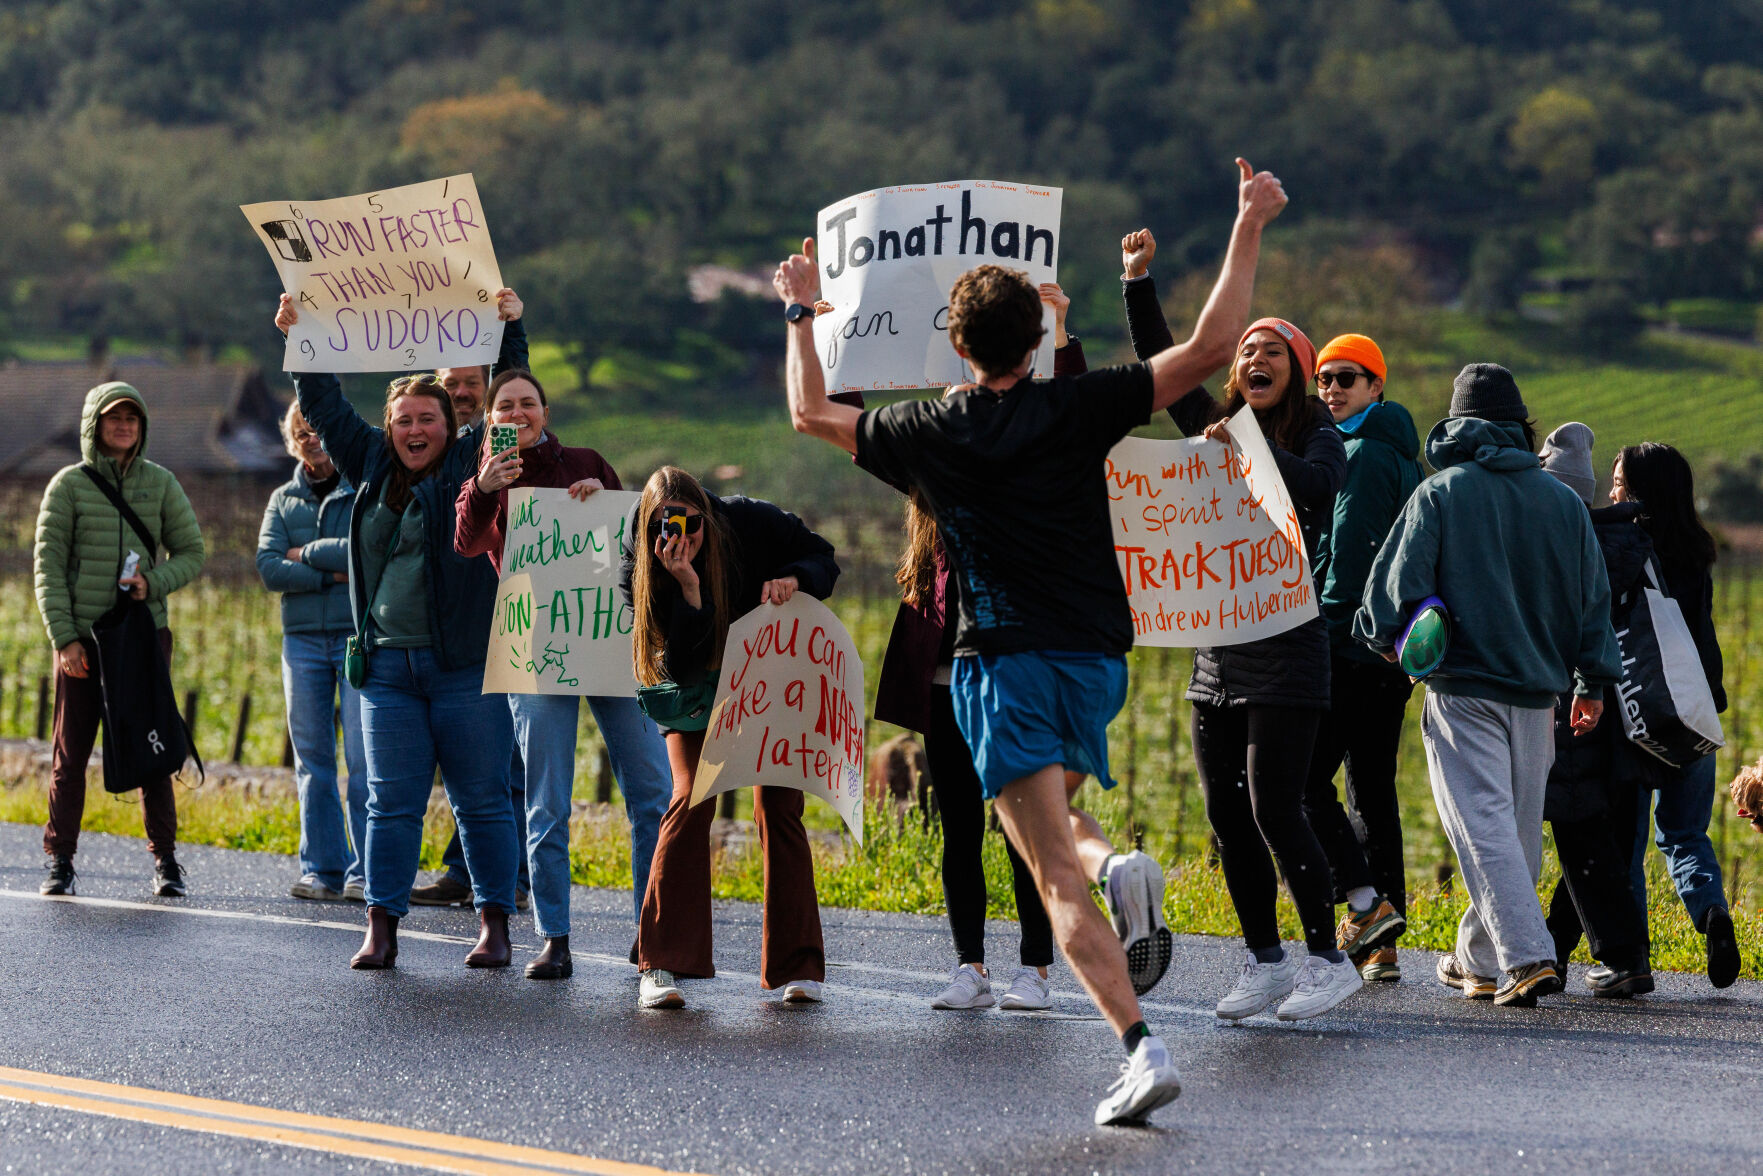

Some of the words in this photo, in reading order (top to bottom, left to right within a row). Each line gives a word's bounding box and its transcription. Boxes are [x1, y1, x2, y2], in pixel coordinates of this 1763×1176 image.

[289, 204, 304, 220] 6
[367, 194, 384, 213] 5
[306, 217, 376, 259] RUN
[379, 198, 479, 252] FASTER
[826, 190, 1054, 279] Jonathan
[300, 290, 318, 310] 4
[401, 293, 412, 309] 7
[477, 289, 489, 302] 8
[310, 262, 395, 302] THAN
[397, 256, 451, 297] YOU
[300, 339, 316, 361] 9
[403, 348, 417, 366] 3
[480, 332, 492, 346] 2
[328, 306, 479, 352] SUDOKO
[1161, 452, 1210, 485] with
[1218, 442, 1252, 485] the
[1142, 488, 1224, 536] spirit
[1237, 477, 1264, 522] of
[509, 518, 604, 573] weather
[1220, 505, 1304, 592] TUESDAY
[1129, 602, 1210, 636] Andrew
[730, 618, 800, 692] you
[715, 680, 772, 740] take
[784, 679, 806, 712] a
[756, 726, 843, 799] later!
